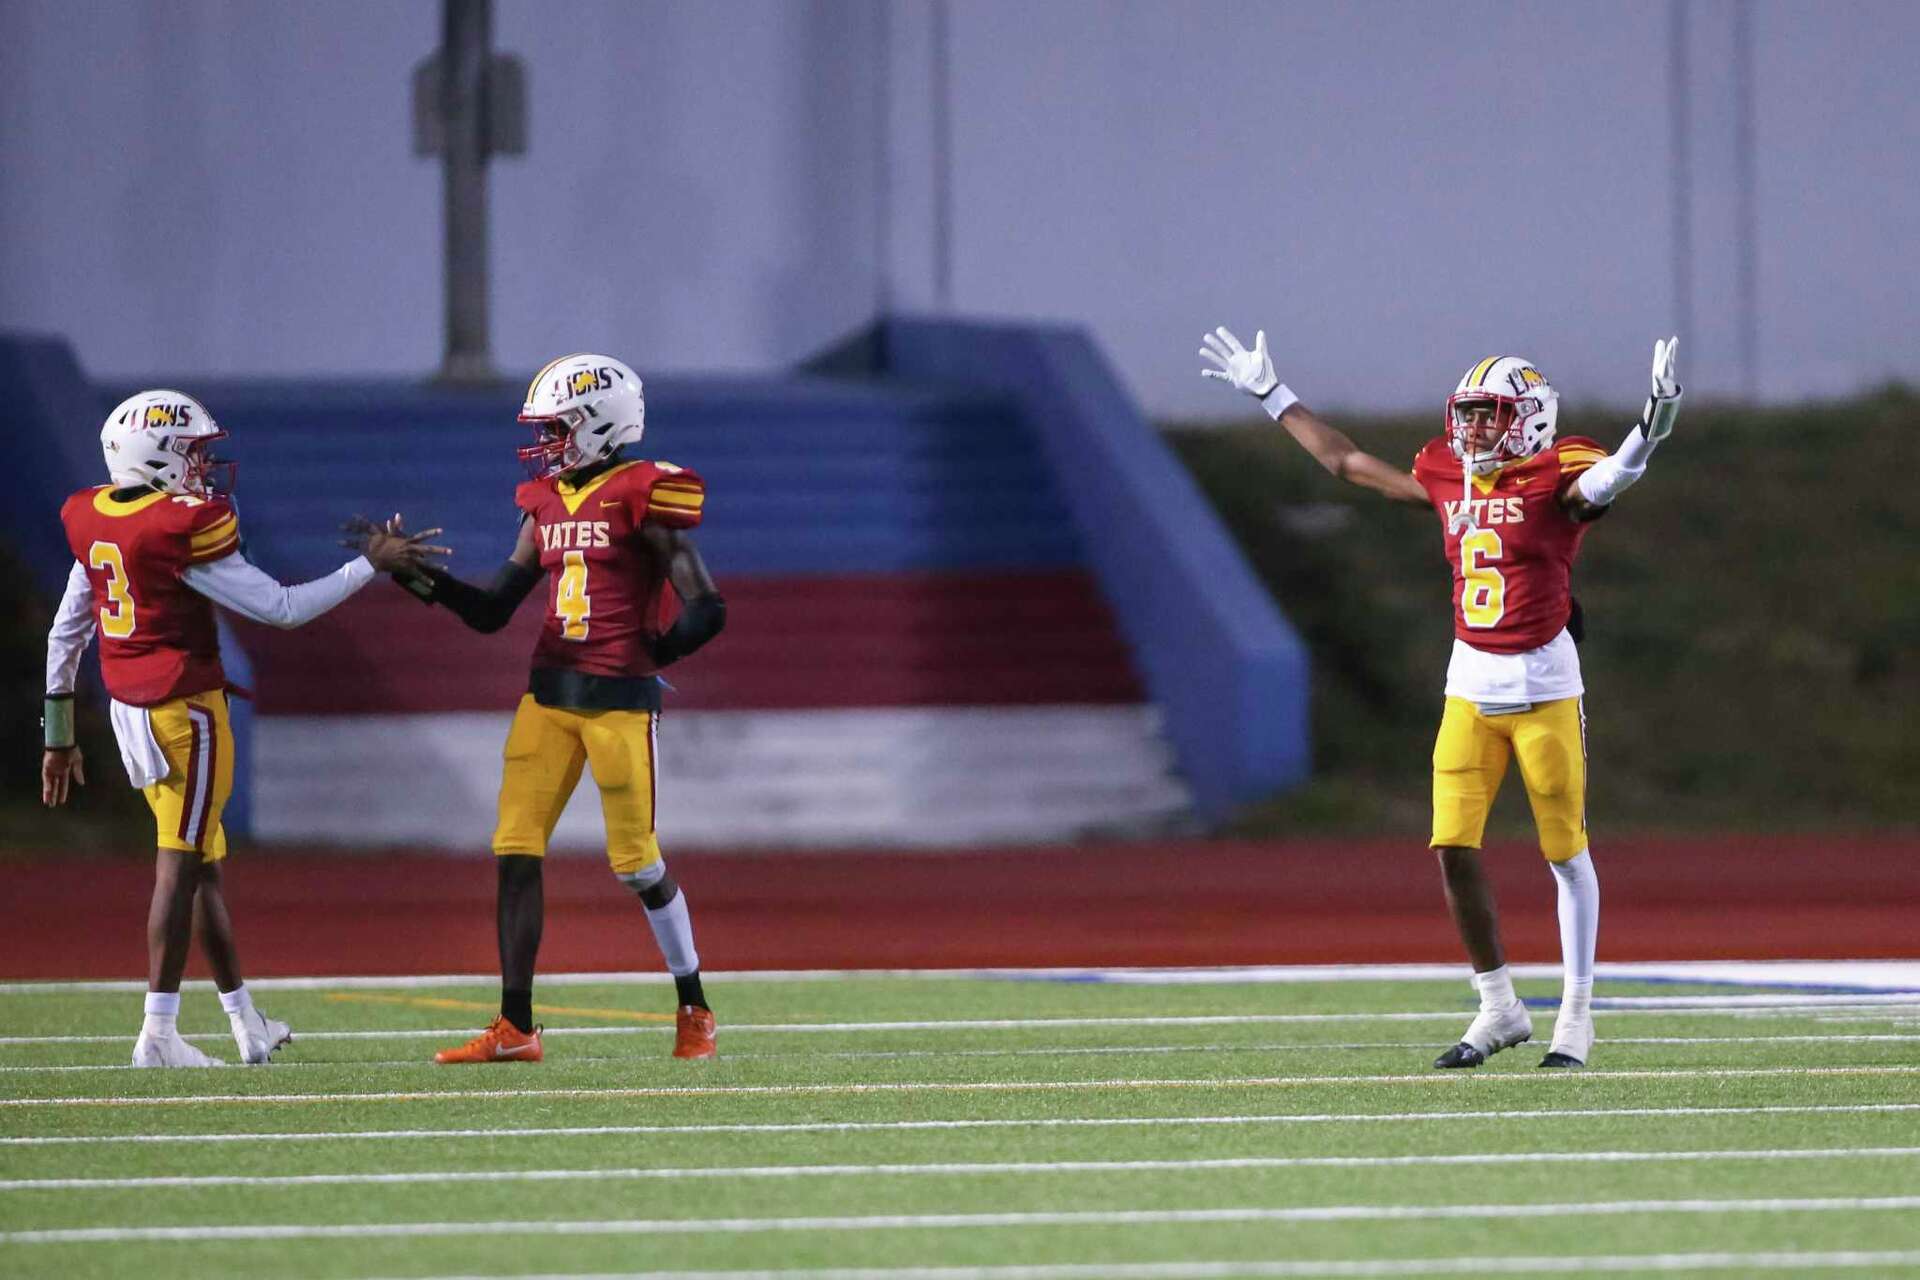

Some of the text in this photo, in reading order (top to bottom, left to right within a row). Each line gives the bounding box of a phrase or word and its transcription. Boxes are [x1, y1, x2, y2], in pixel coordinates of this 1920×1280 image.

[540, 520, 610, 551] YATES
[1460, 527, 1505, 628] 6
[89, 540, 137, 639] 3
[555, 550, 591, 641] 4
